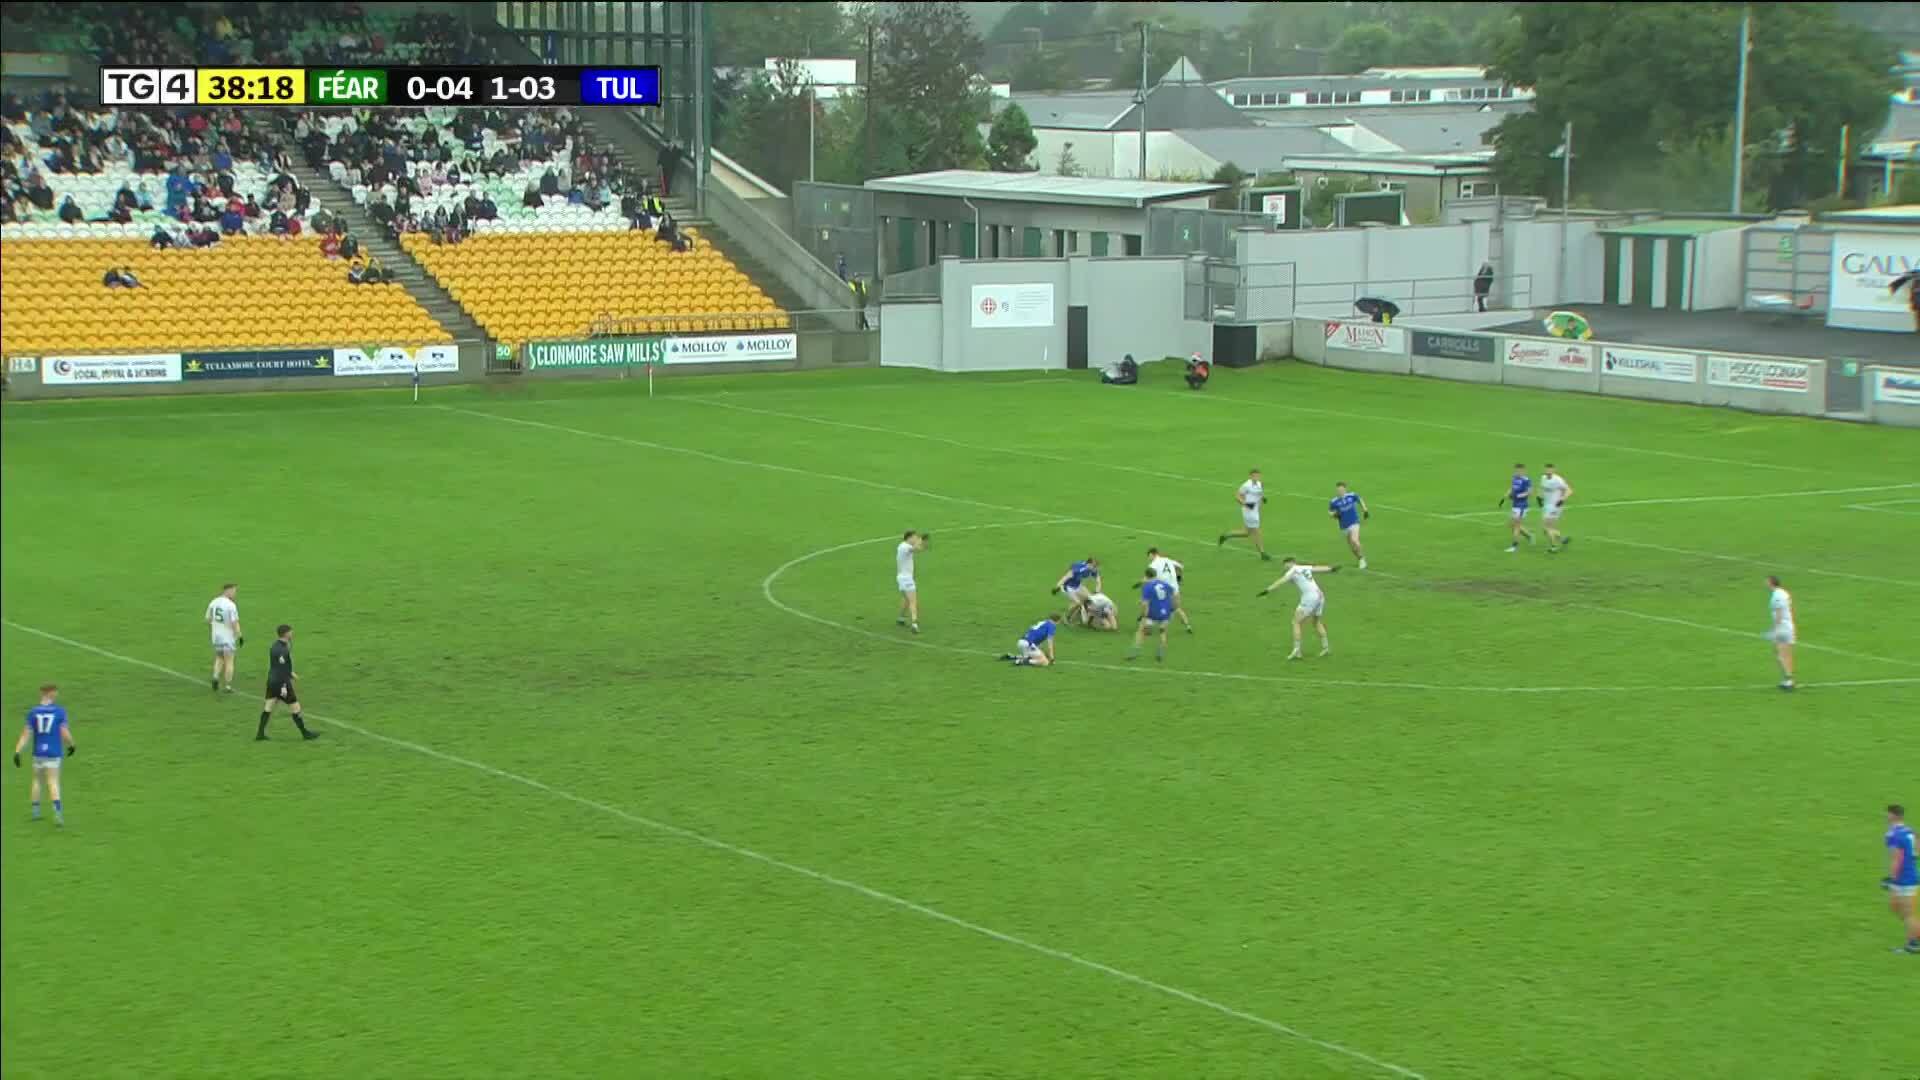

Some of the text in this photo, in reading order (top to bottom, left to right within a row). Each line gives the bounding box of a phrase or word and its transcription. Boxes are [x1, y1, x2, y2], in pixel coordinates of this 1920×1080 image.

[1841, 252, 1920, 276] GALV
[536, 339, 660, 366] CLONMORE SAW MILLS
[681, 341, 727, 353] MOLLOY
[747, 339, 792, 351] MOLLOY
[256, 360, 285, 369] COURT
[286, 360, 313, 368] HOTEL
[36, 713, 55, 734] 17
